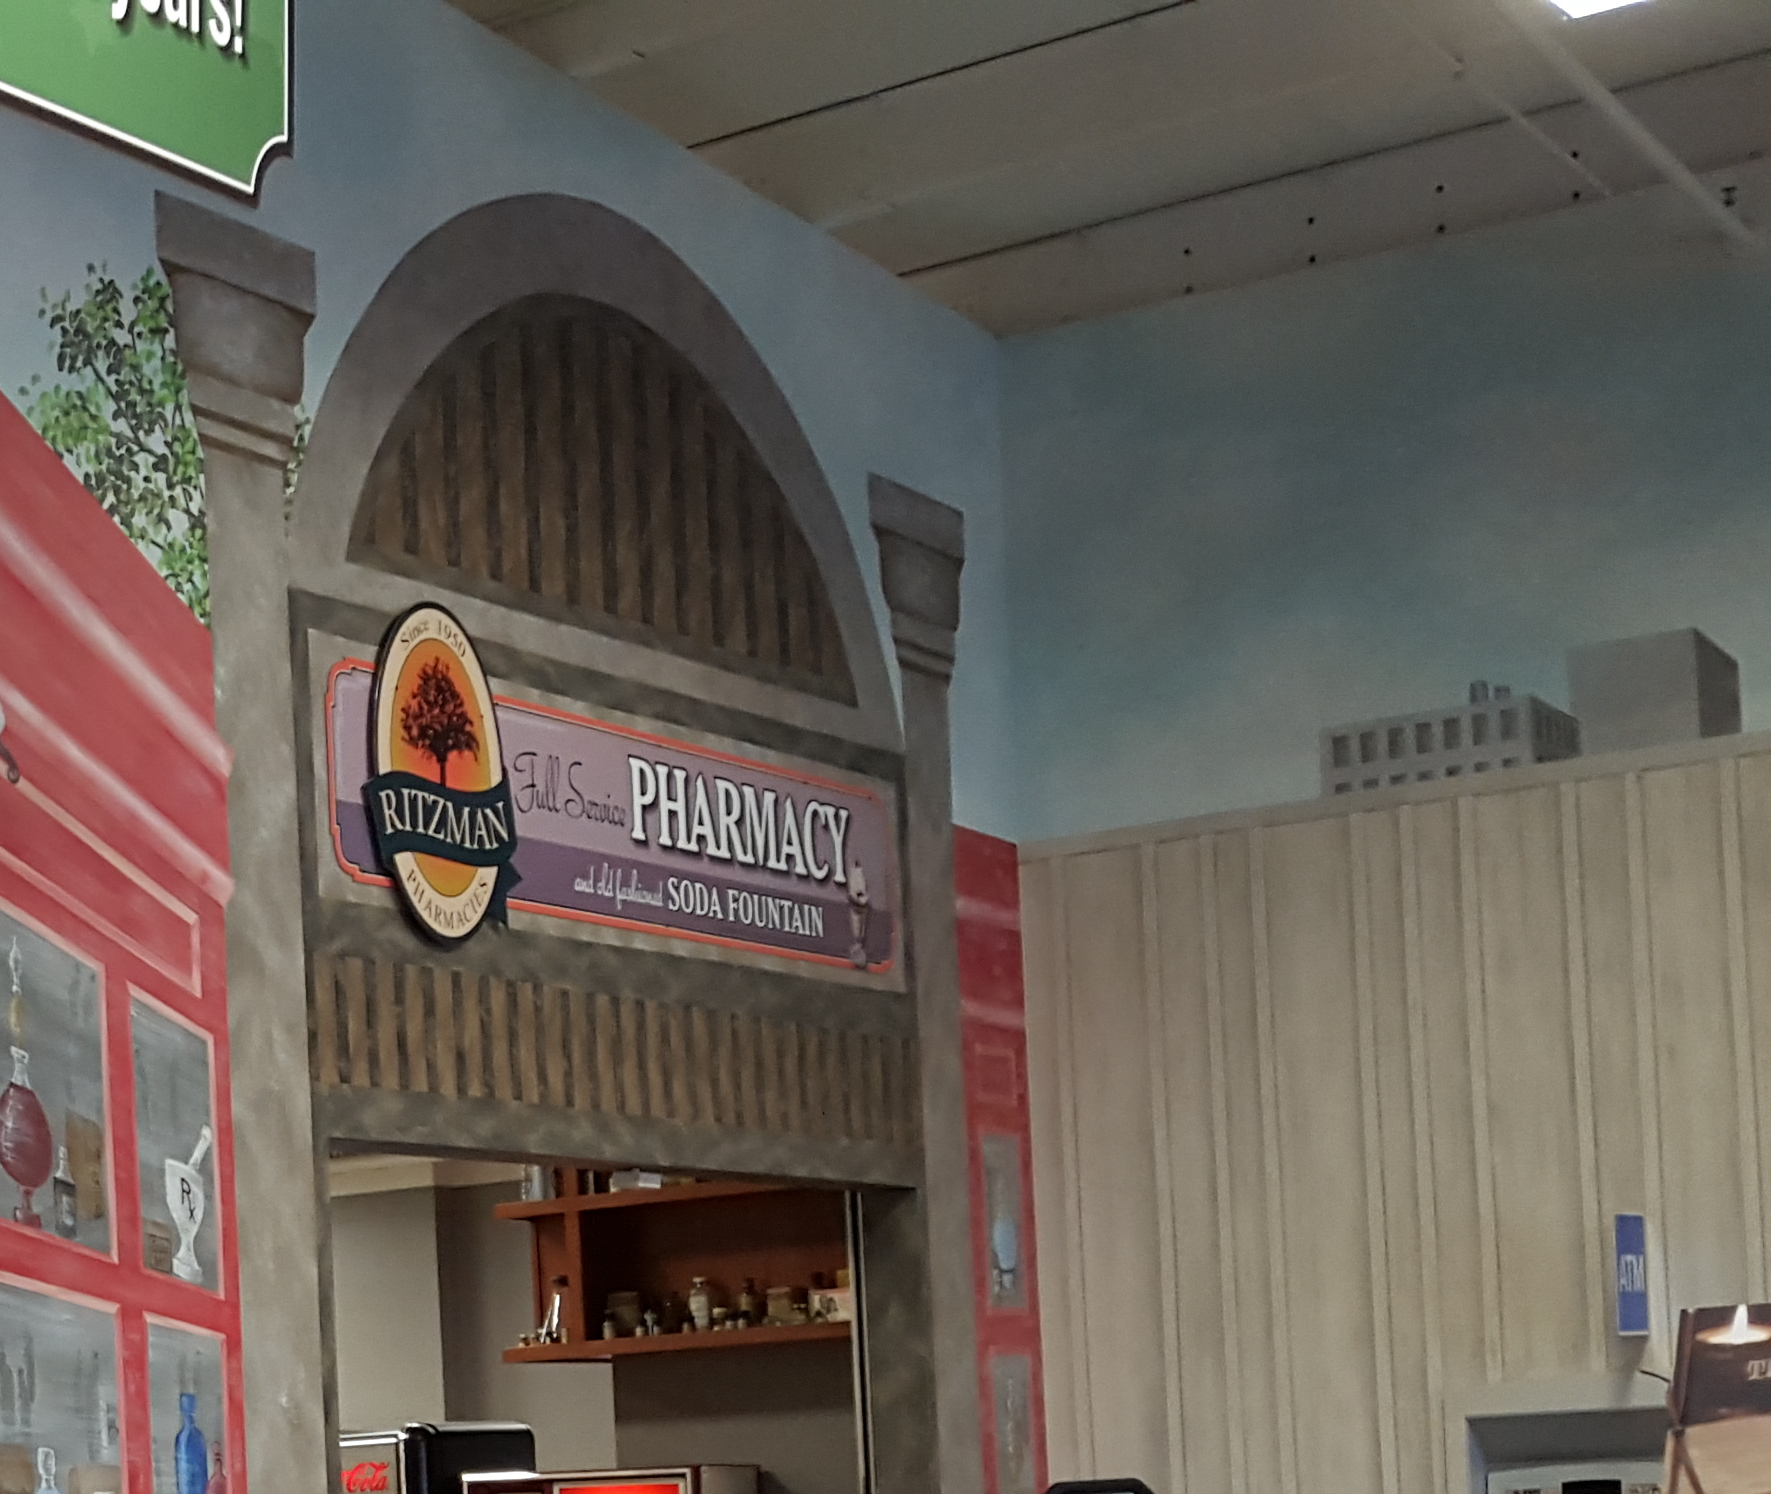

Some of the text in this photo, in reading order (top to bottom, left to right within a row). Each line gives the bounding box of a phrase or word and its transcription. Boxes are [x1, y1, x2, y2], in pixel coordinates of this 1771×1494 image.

[378, 787, 510, 851] RITZMAN
[513, 751, 851, 885] Full Service PHARMACY
[406, 867, 489, 930] PHARMACIES
[666, 875, 825, 938] SODA FOUNTAIN
[1618, 1253, 1645, 1293] ATM
